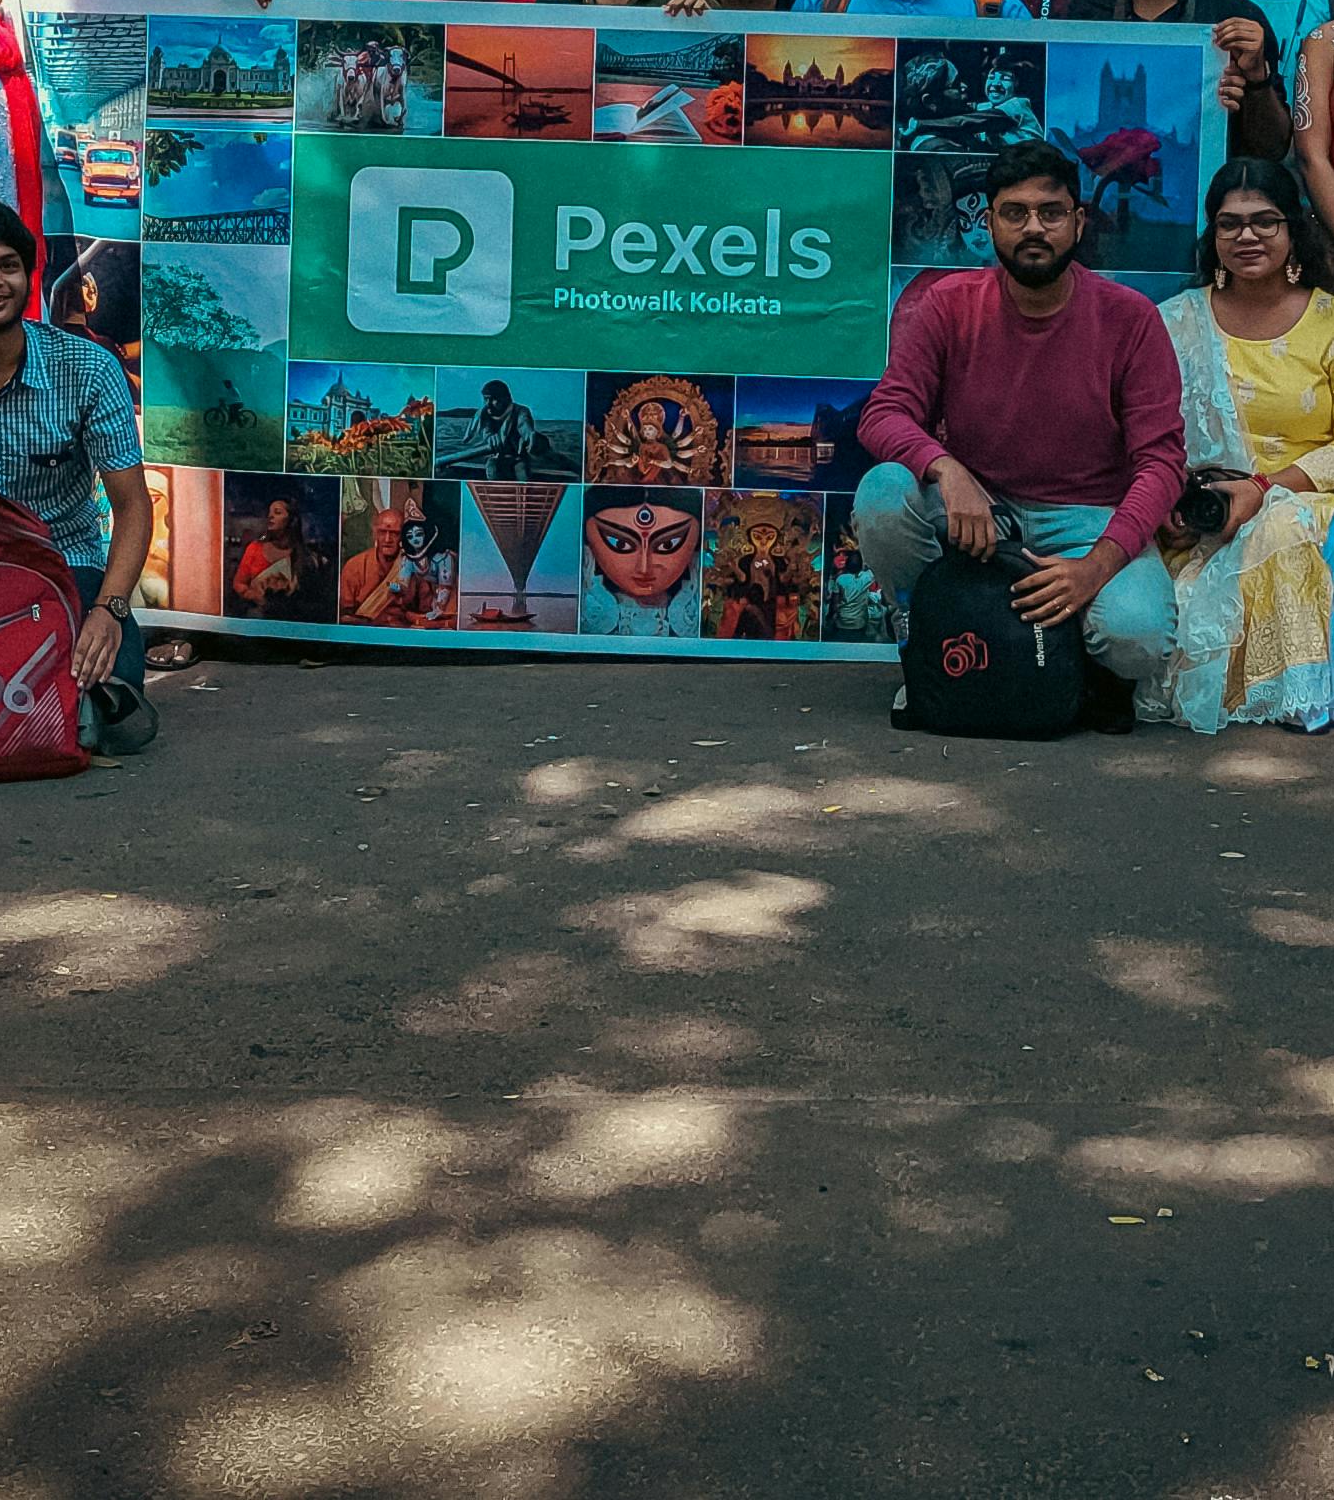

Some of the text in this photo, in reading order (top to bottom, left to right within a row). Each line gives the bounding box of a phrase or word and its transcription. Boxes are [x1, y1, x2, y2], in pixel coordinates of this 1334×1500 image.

[556, 205, 832, 280] Pexels
[554, 287, 782, 316] Photowalk Kolkata
